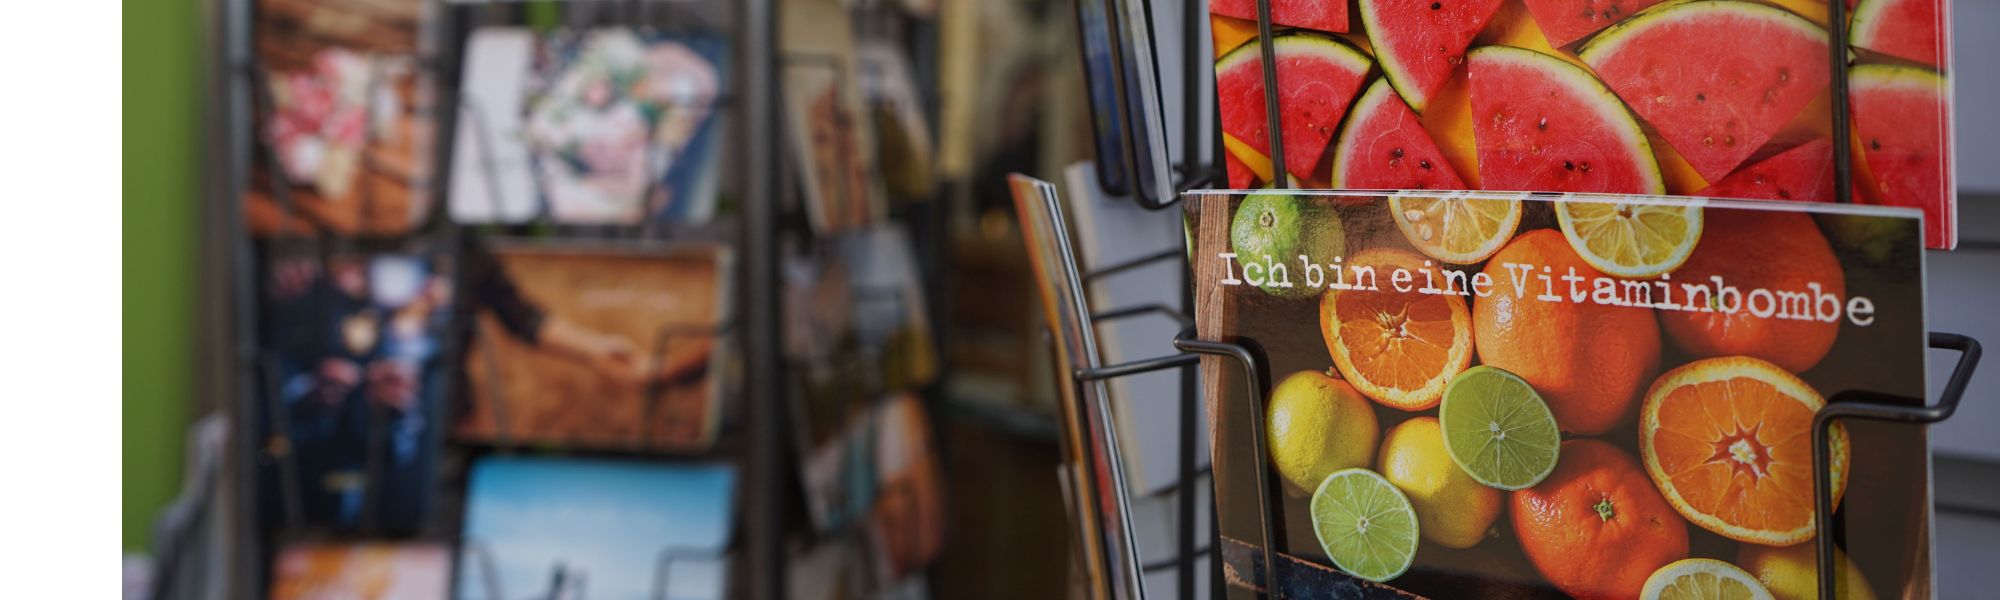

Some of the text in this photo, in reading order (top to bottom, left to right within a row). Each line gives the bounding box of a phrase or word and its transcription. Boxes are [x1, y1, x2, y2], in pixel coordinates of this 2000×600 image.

[1218, 252, 1875, 326] Ich bin eine Vitaminbombe
